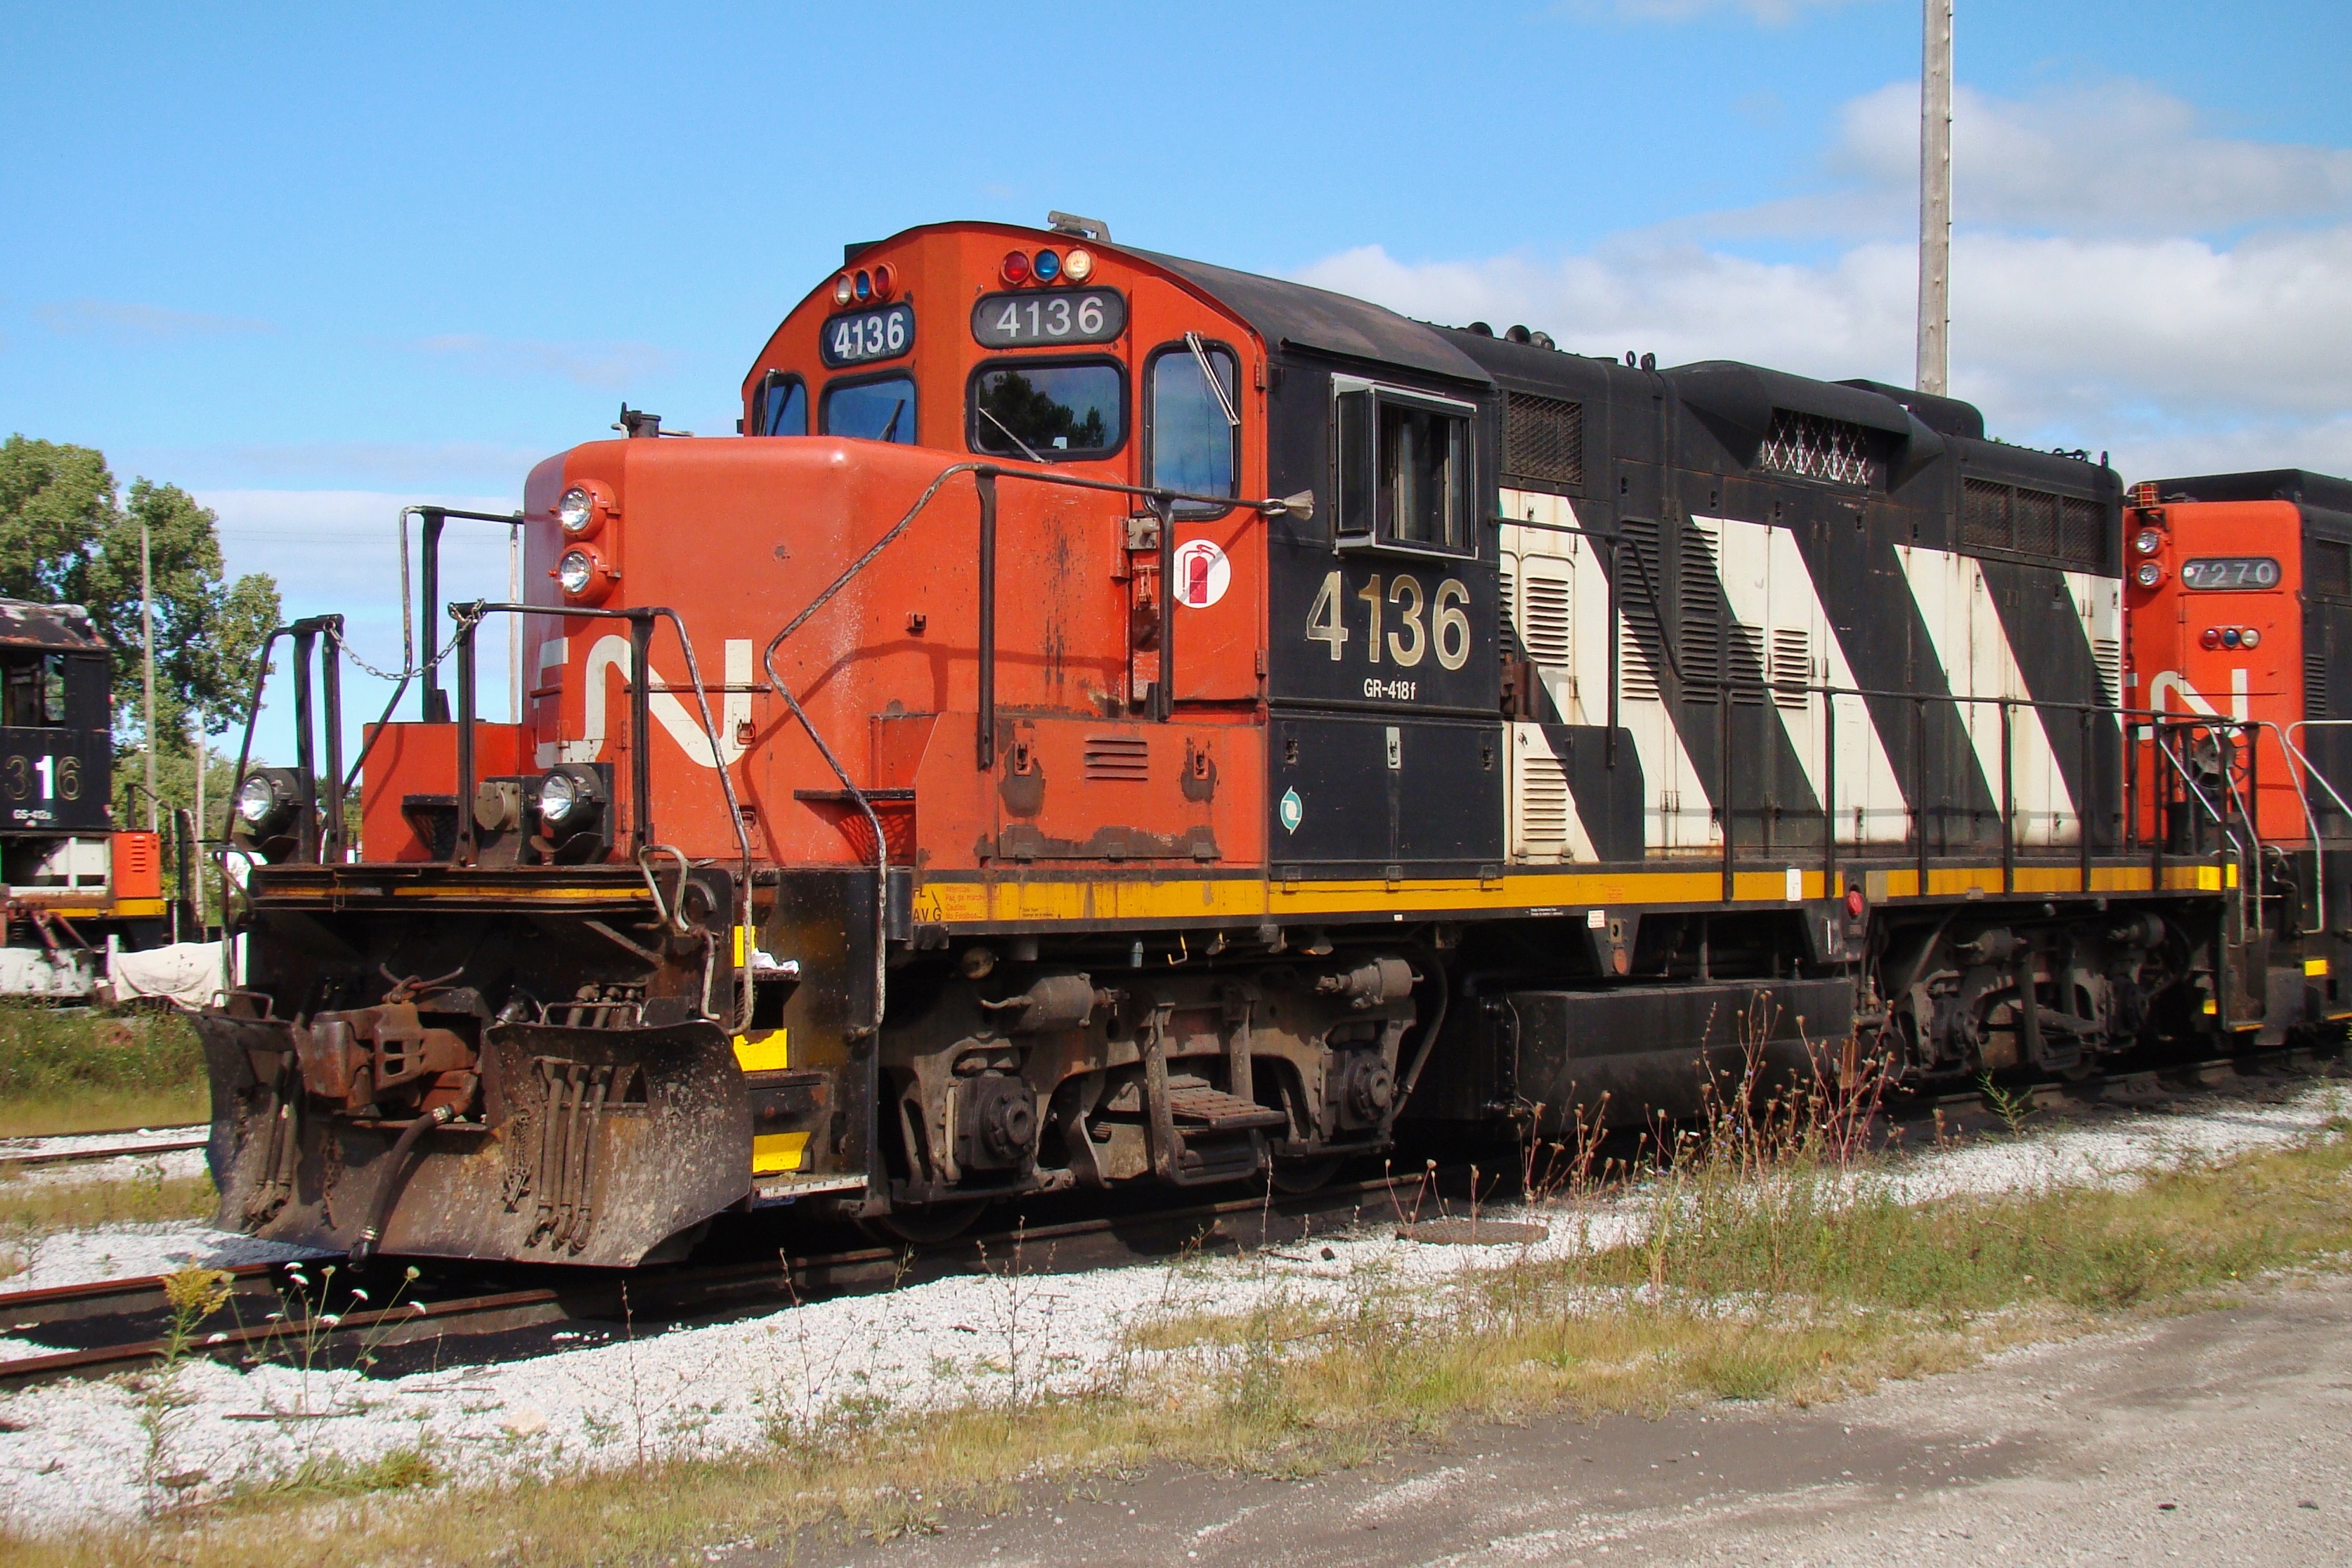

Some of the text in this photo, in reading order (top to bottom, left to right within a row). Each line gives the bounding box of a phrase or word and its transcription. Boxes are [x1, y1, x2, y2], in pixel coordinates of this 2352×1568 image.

[834, 311, 904, 356] 4136
[996, 296, 1104, 337] 4136
[2191, 563, 2273, 585] 7270
[1306, 570, 1471, 671] 4136
[1363, 678, 1416, 700] GR-418f
